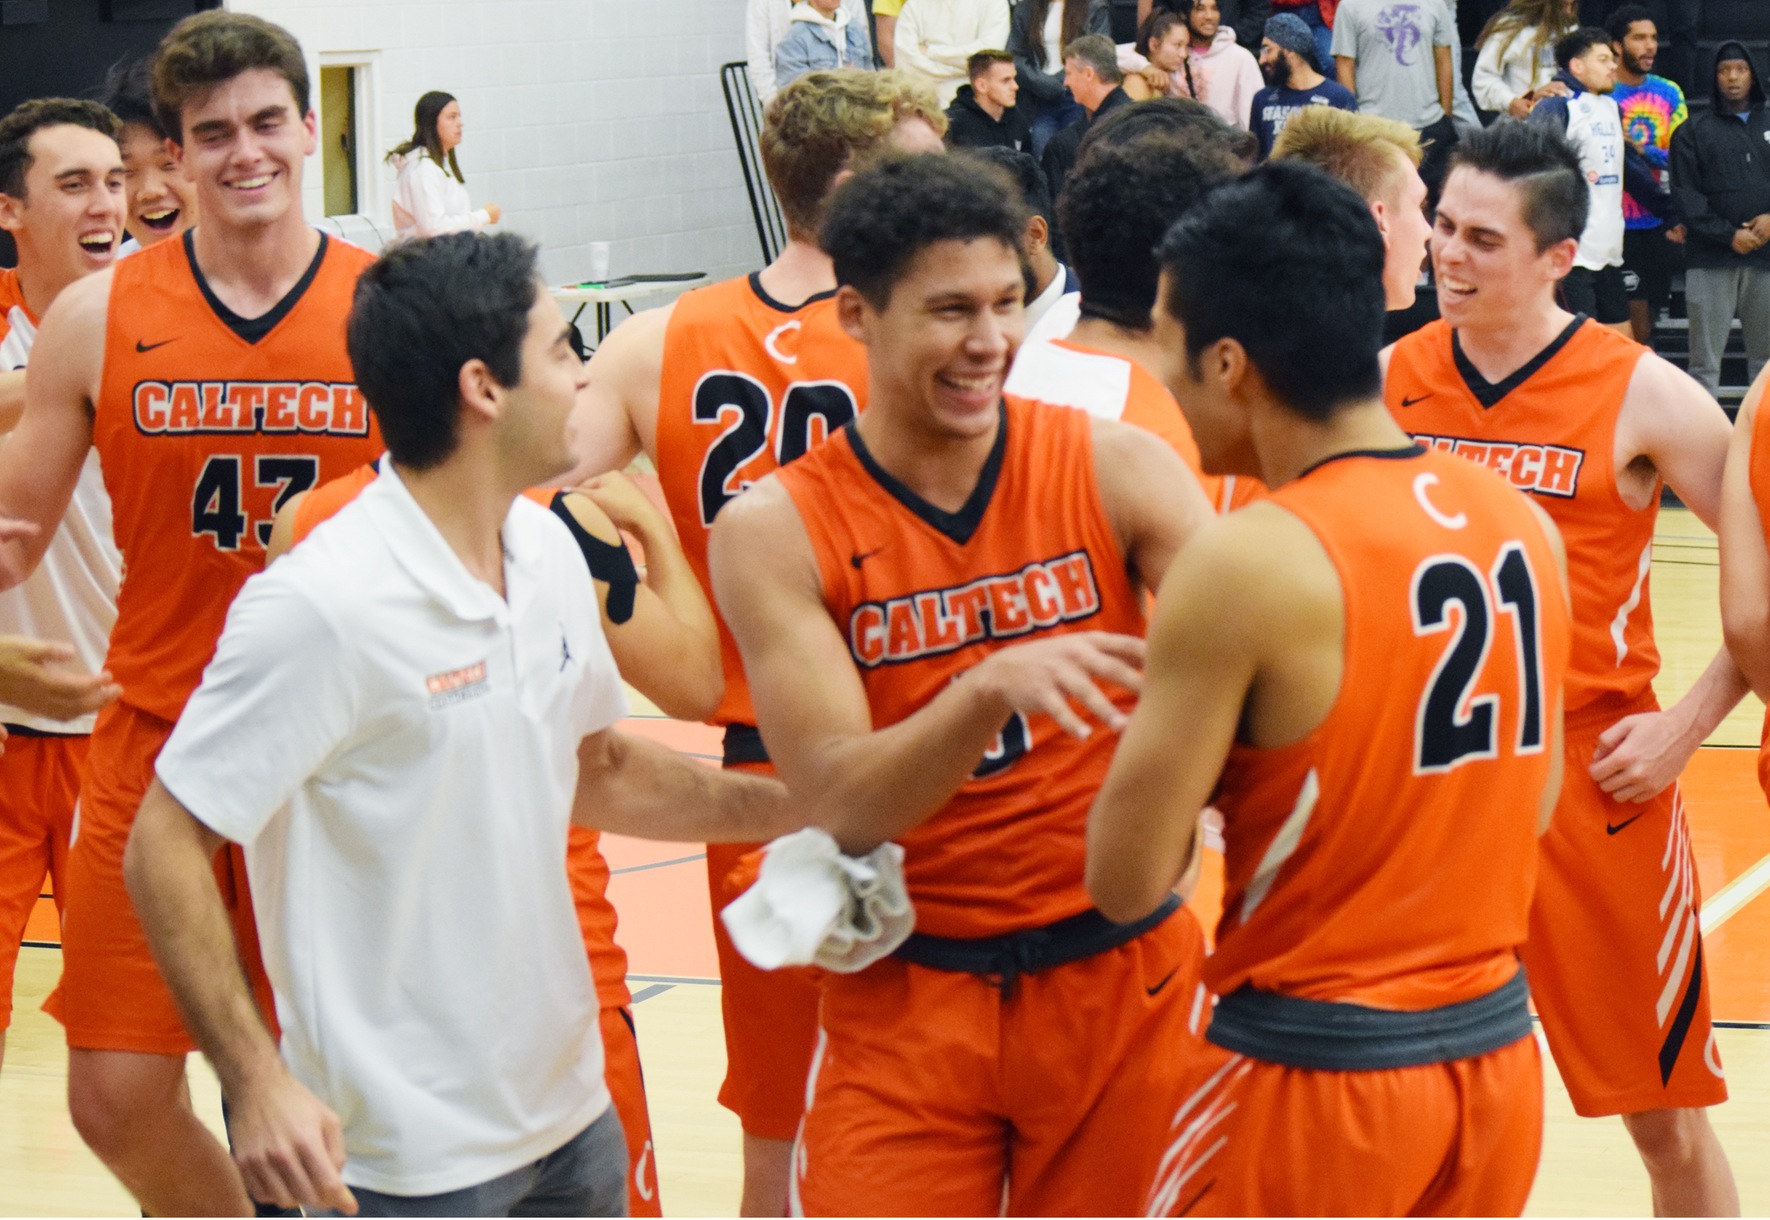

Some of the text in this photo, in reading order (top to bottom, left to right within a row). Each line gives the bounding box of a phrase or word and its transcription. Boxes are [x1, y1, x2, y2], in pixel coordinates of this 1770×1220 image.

[132, 380, 372, 437] CALTECH
[850, 549, 1101, 669] CALTECH
[1409, 540, 1546, 777] 21
